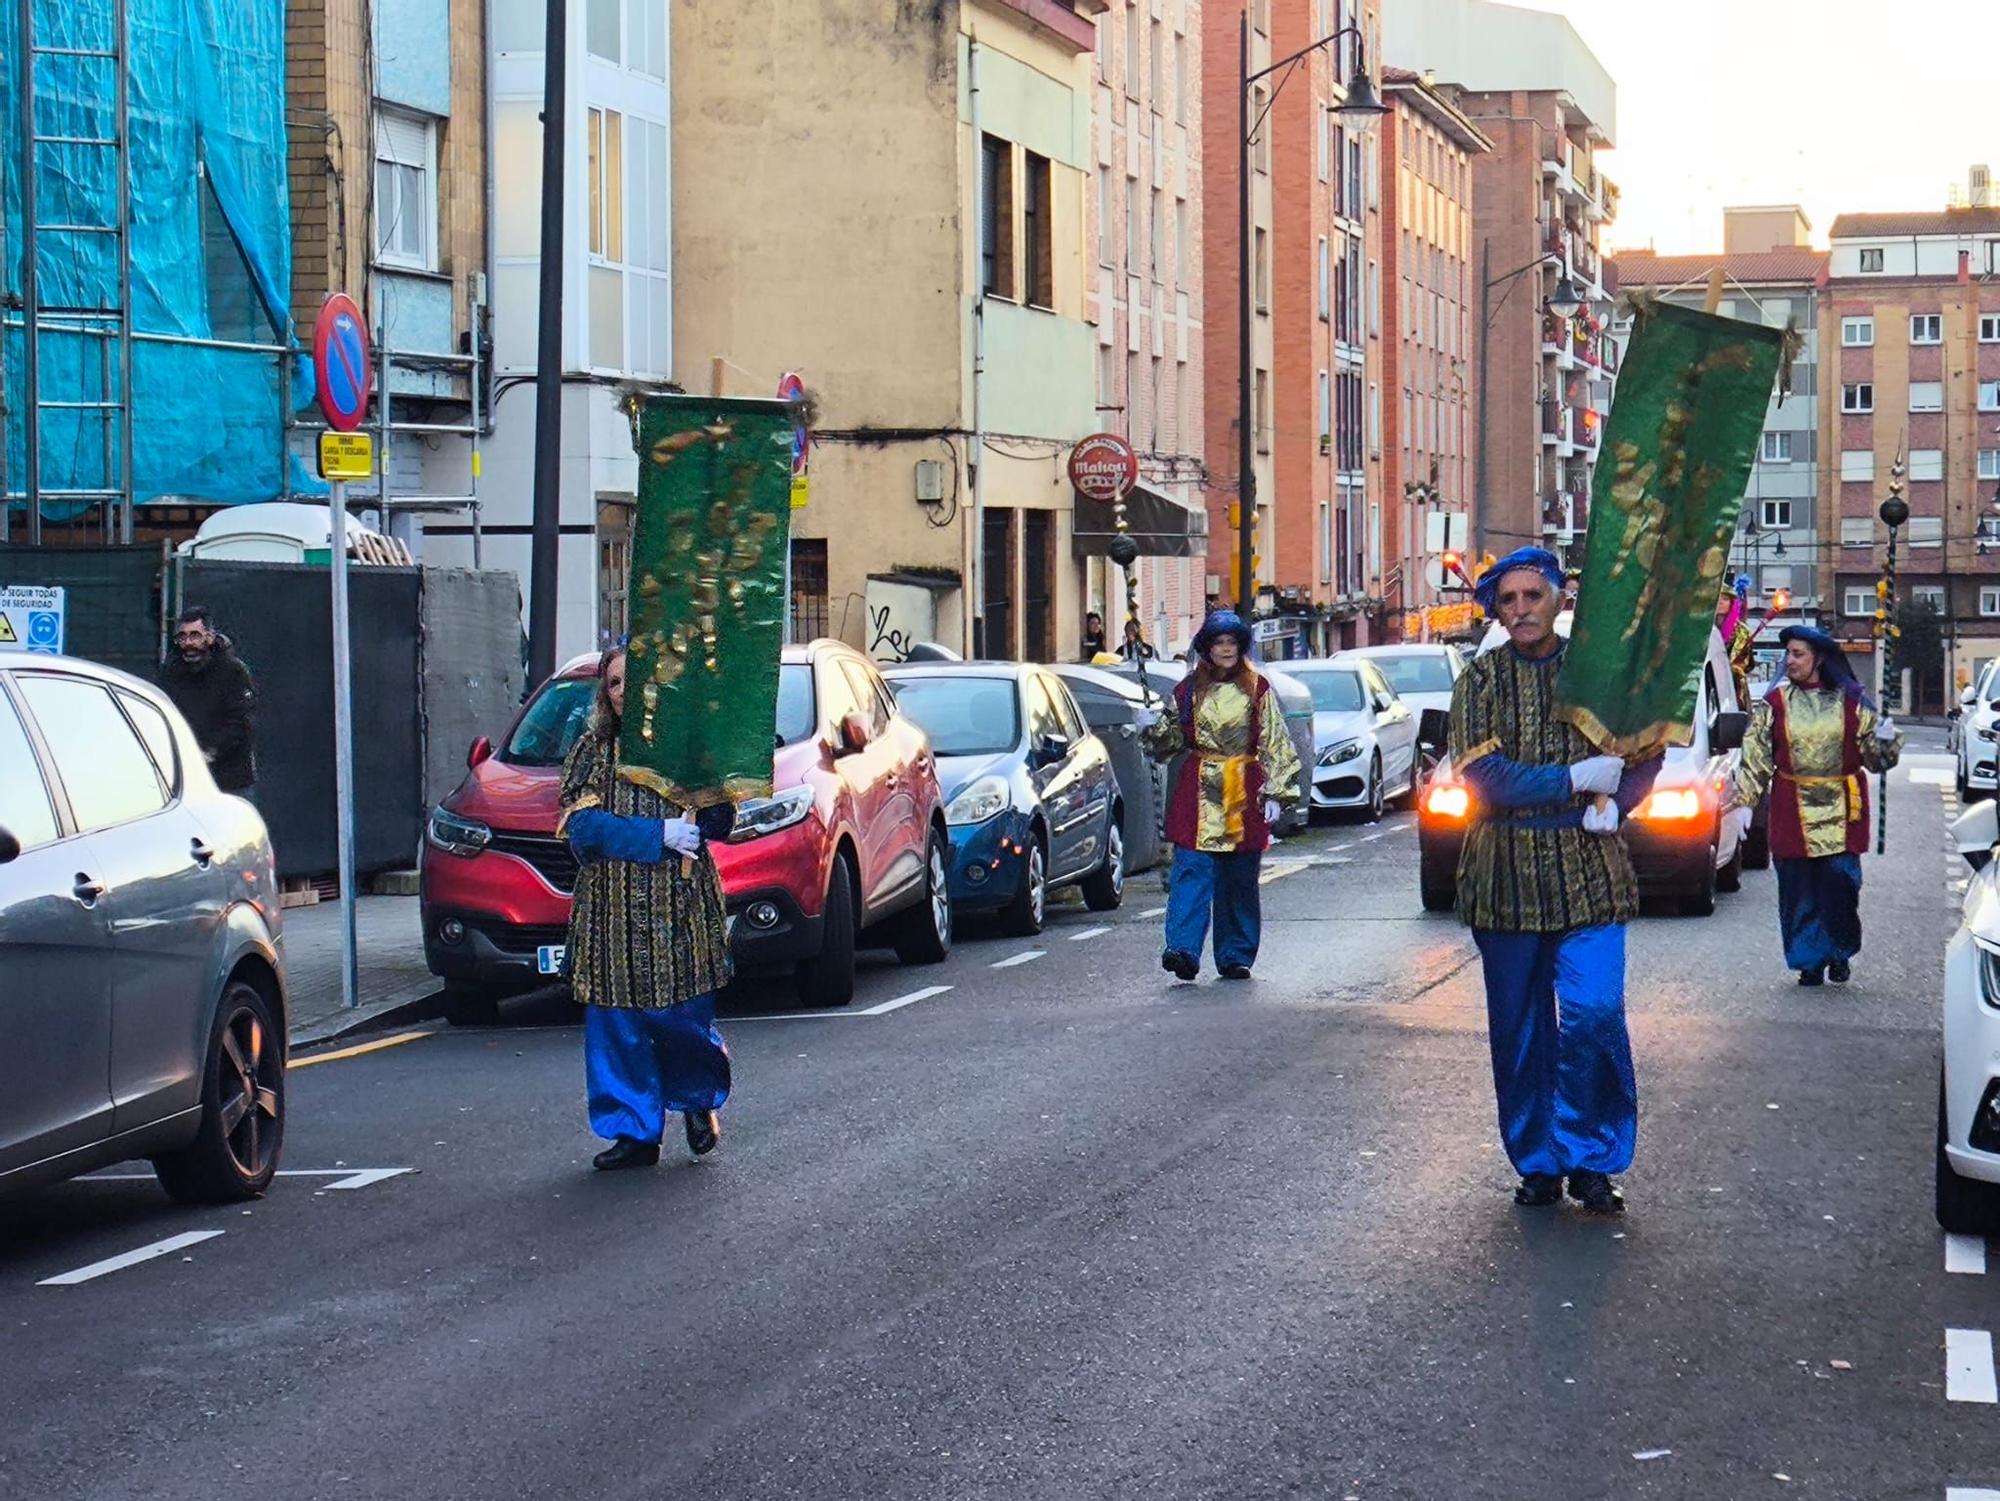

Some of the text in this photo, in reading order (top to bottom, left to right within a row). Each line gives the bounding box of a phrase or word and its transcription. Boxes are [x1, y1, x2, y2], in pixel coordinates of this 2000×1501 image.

[8, 589, 33, 597] SEGUIR
[35, 589, 57, 598] TODAS
[13, 600, 52, 608] SEGURIDAD
